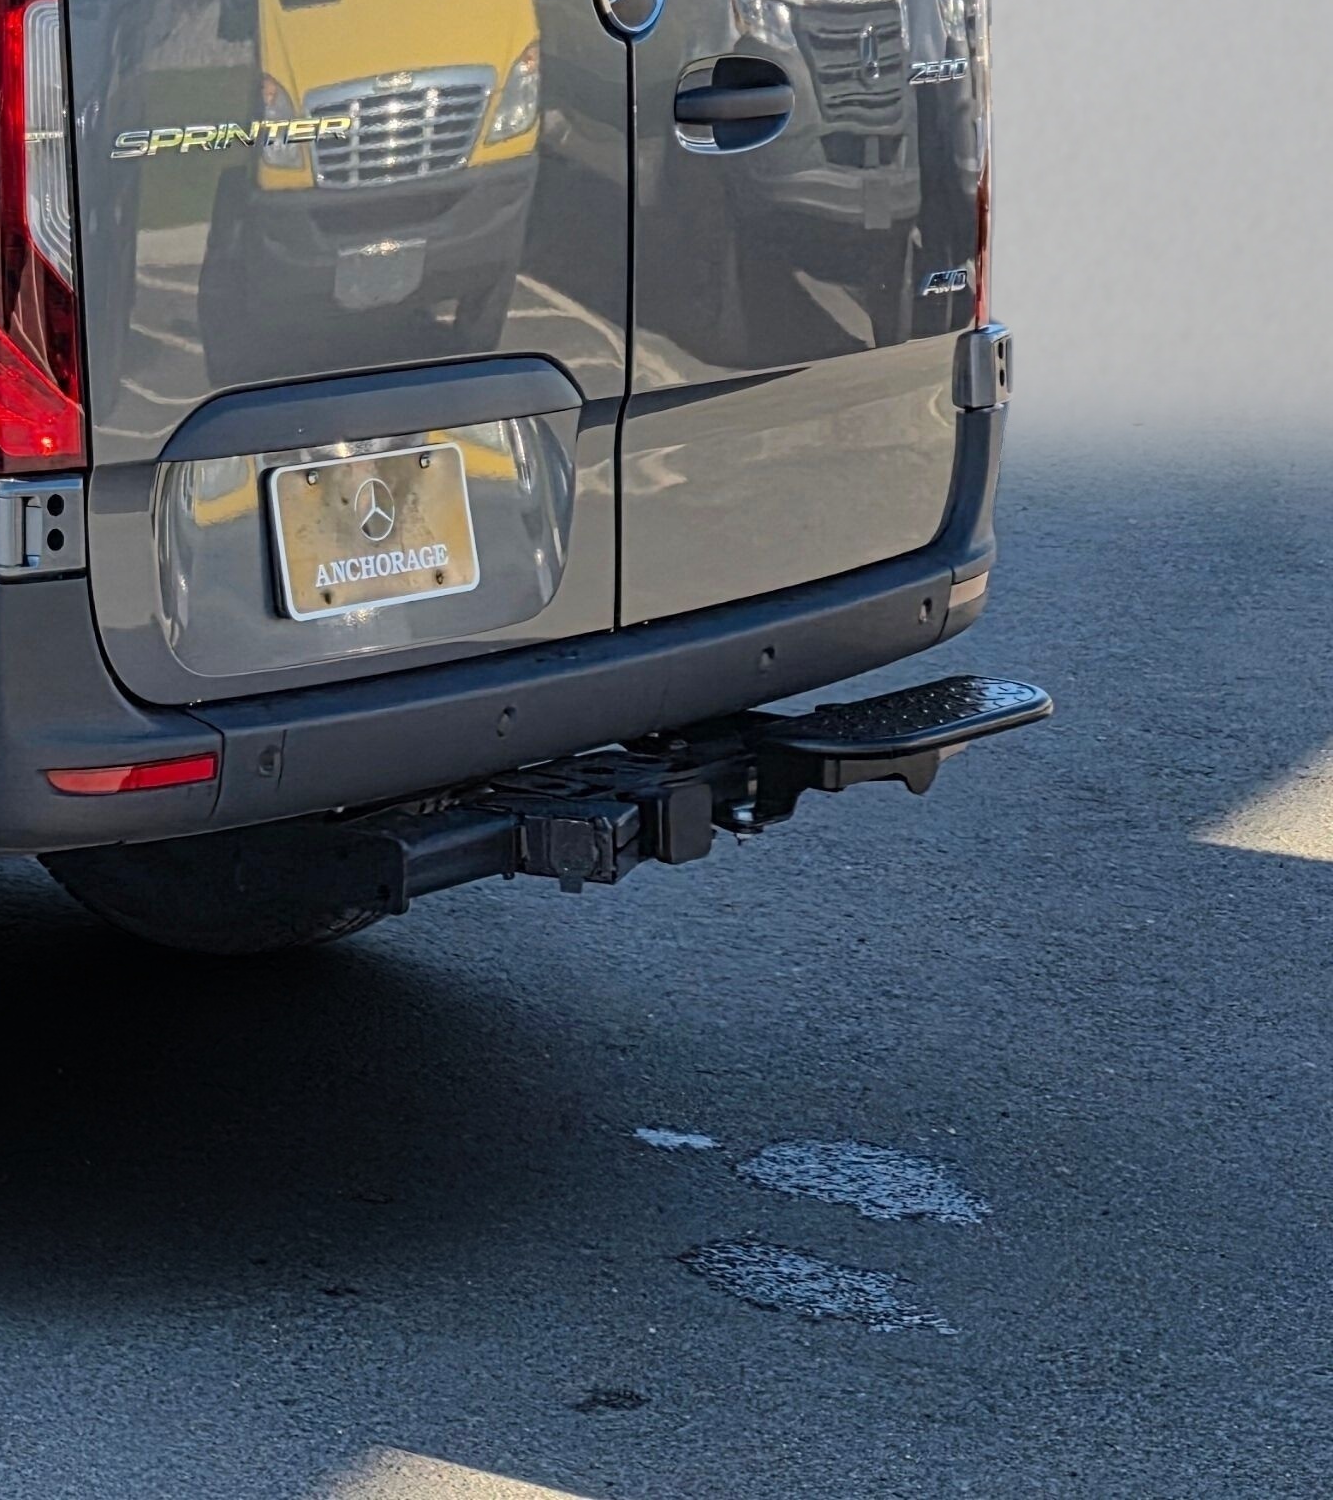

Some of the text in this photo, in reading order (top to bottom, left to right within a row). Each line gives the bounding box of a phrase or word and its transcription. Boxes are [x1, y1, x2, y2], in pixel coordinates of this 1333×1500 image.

[909, 57, 968, 85] 2500
[110, 116, 352, 159] SPRINTER
[315, 543, 450, 588] ANCHORAGE
